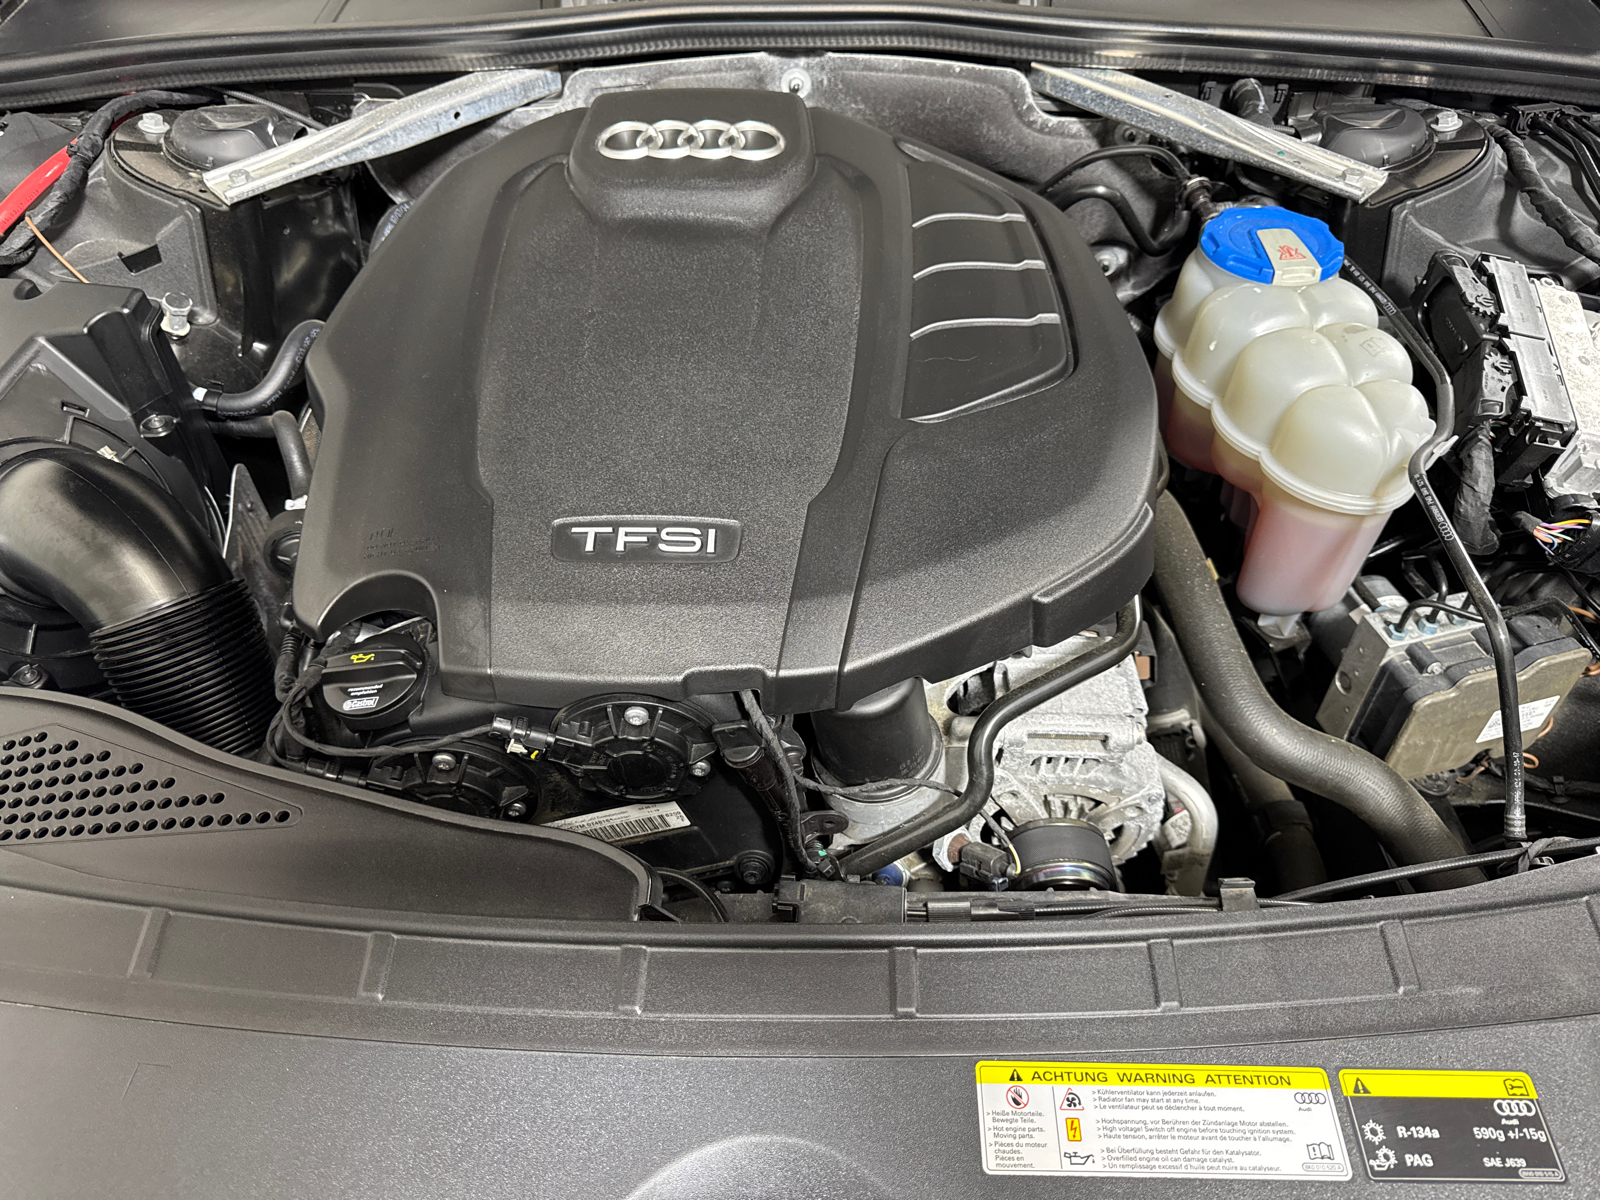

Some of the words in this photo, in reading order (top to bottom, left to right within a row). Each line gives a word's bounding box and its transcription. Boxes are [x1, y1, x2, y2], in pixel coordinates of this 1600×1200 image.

[571, 526, 716, 554] TFSI
[351, 698, 375, 708] Castrol
[1031, 1071, 1109, 1083] ACHTUNG
[1116, 1072, 1196, 1084] WARNING
[1204, 1073, 1292, 1086] ATTENTION
[1141, 1104, 1155, 1112] peut
[1201, 1119, 1238, 1127] Zündanlage
[1102, 1125, 1117, 1133] High
[1219, 1127, 1247, 1135] touching
[1271, 1128, 1296, 1136] system.
[1396, 1125, 1441, 1139] R-134a
[1472, 1127, 1506, 1142] 590g
[1507, 1127, 1548, 1143] +/-15g
[993, 1132, 1017, 1140] Moving
[1117, 1146, 1155, 1156] Überfüllung
[1182, 1156, 1208, 1164] damage
[1404, 1153, 1434, 1167] PAG
[1482, 1157, 1504, 1167] SAE
[1504, 1157, 1527, 1167] J639
[1118, 1163, 1157, 1171] remplissage
